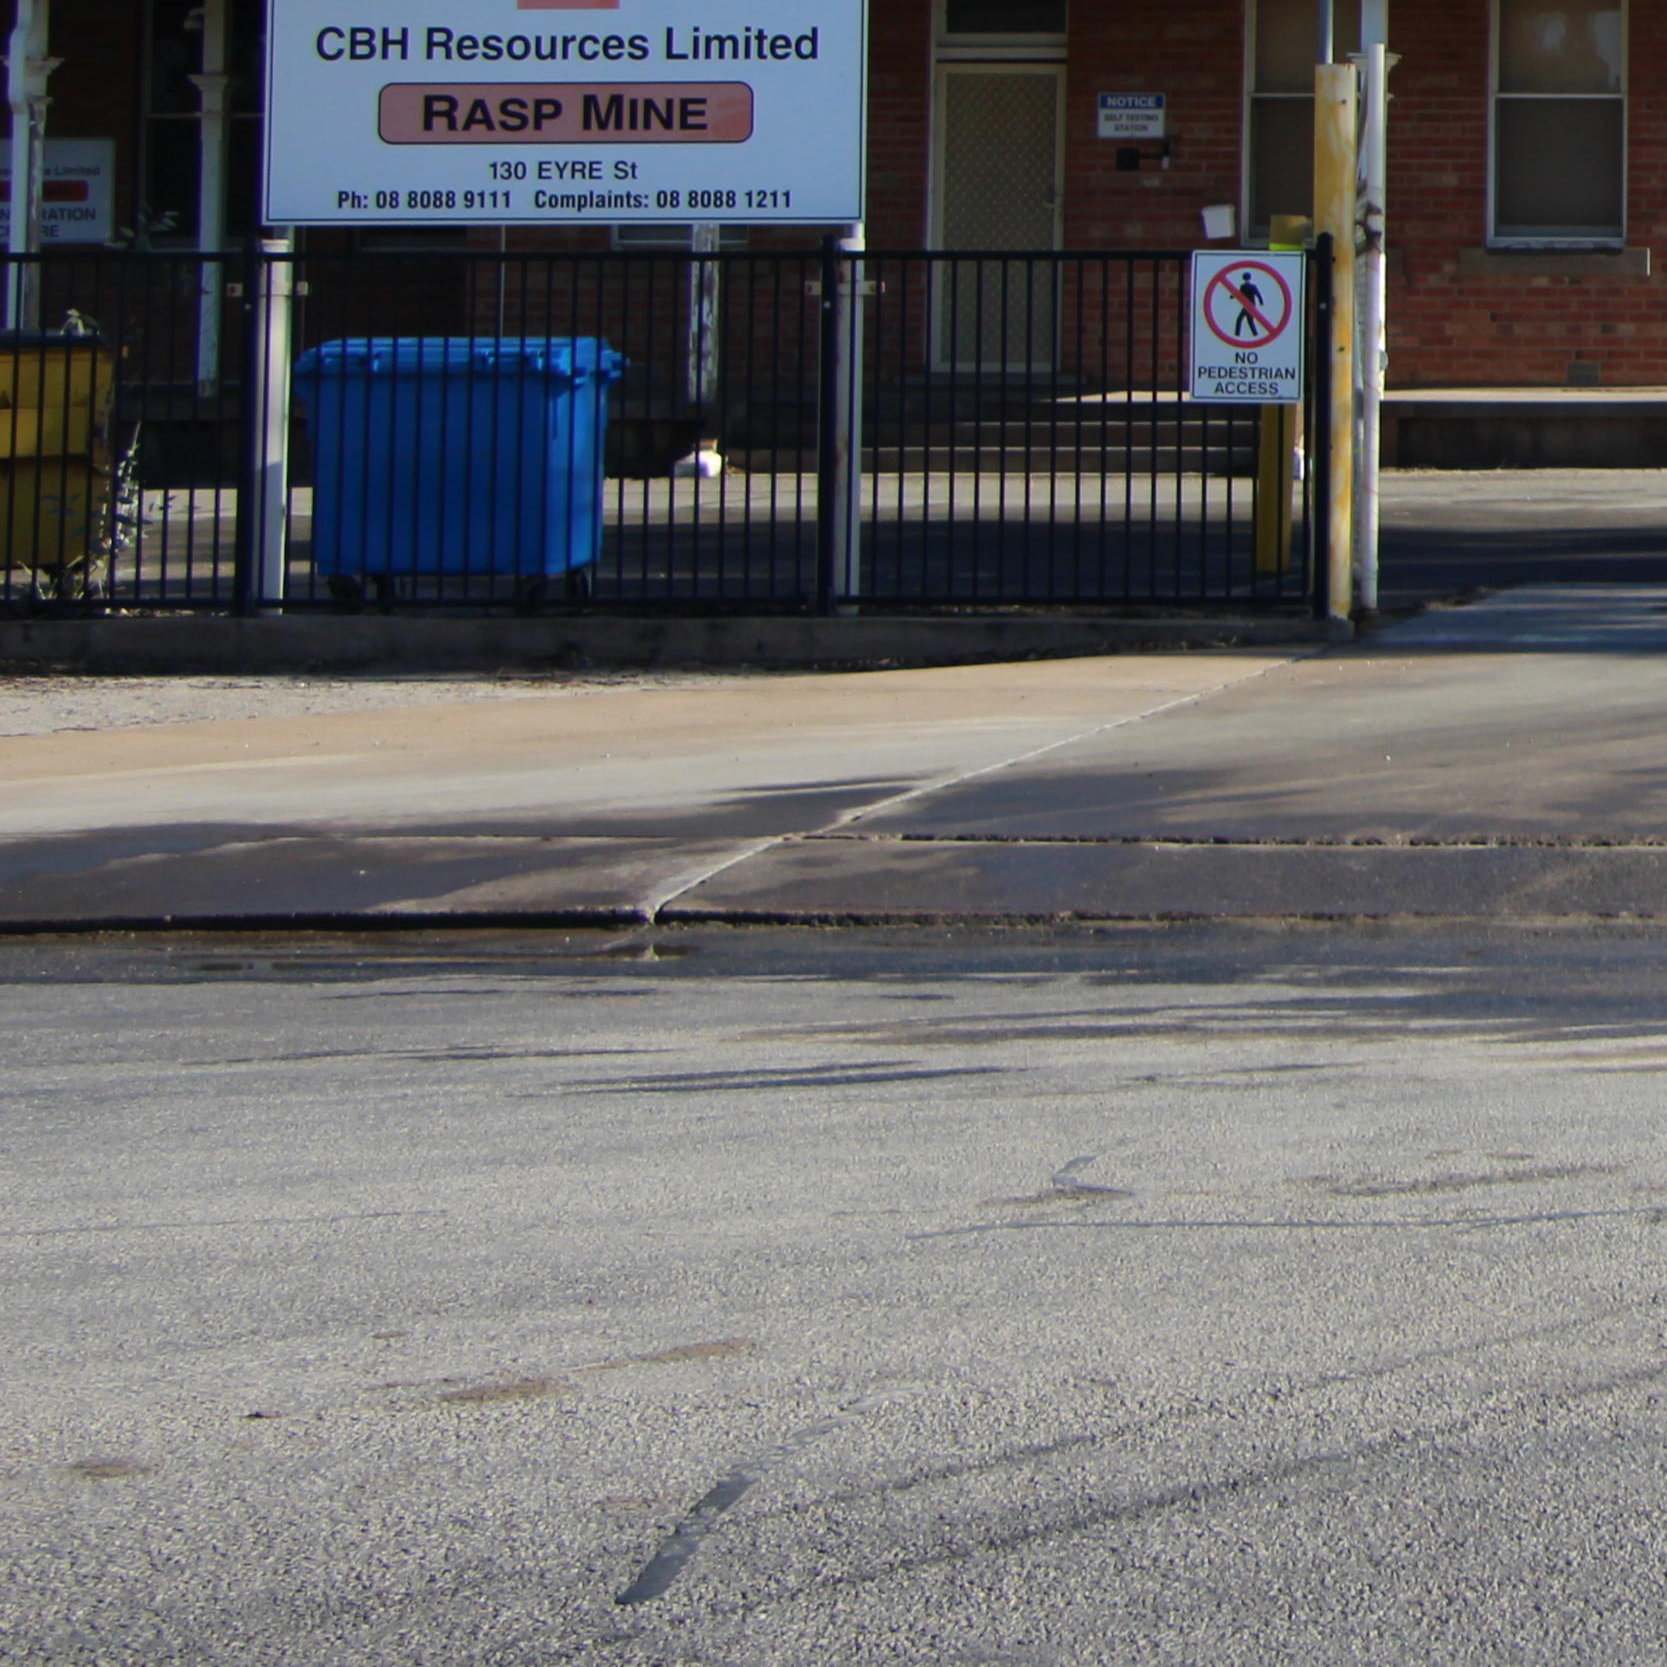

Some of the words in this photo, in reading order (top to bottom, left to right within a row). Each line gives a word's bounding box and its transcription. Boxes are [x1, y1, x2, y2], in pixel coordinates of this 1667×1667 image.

[316, 26, 410, 61] CBH
[425, 26, 650, 61] Resources
[665, 25, 819, 61] Limited
[1106, 96, 1156, 108] NOTICE
[423, 94, 563, 132] RASP
[582, 93, 709, 132] MINE
[489, 160, 527, 181] 130
[538, 160, 603, 180] EYRE
[613, 160, 638, 180] St
[337, 191, 368, 209] Ph:
[375, 191, 400, 209] 08
[407, 191, 456, 209] 8088
[463, 191, 511, 209] 9111
[534, 190, 649, 213] Complaints:
[656, 190, 680, 209] 08
[688, 190, 737, 209] 8088
[745, 190, 791, 209] 1211
[1234, 351, 1259, 365] NO
[1197, 366, 1297, 380] PEDESTRIAN
[1213, 381, 1280, 395] ACCESS
